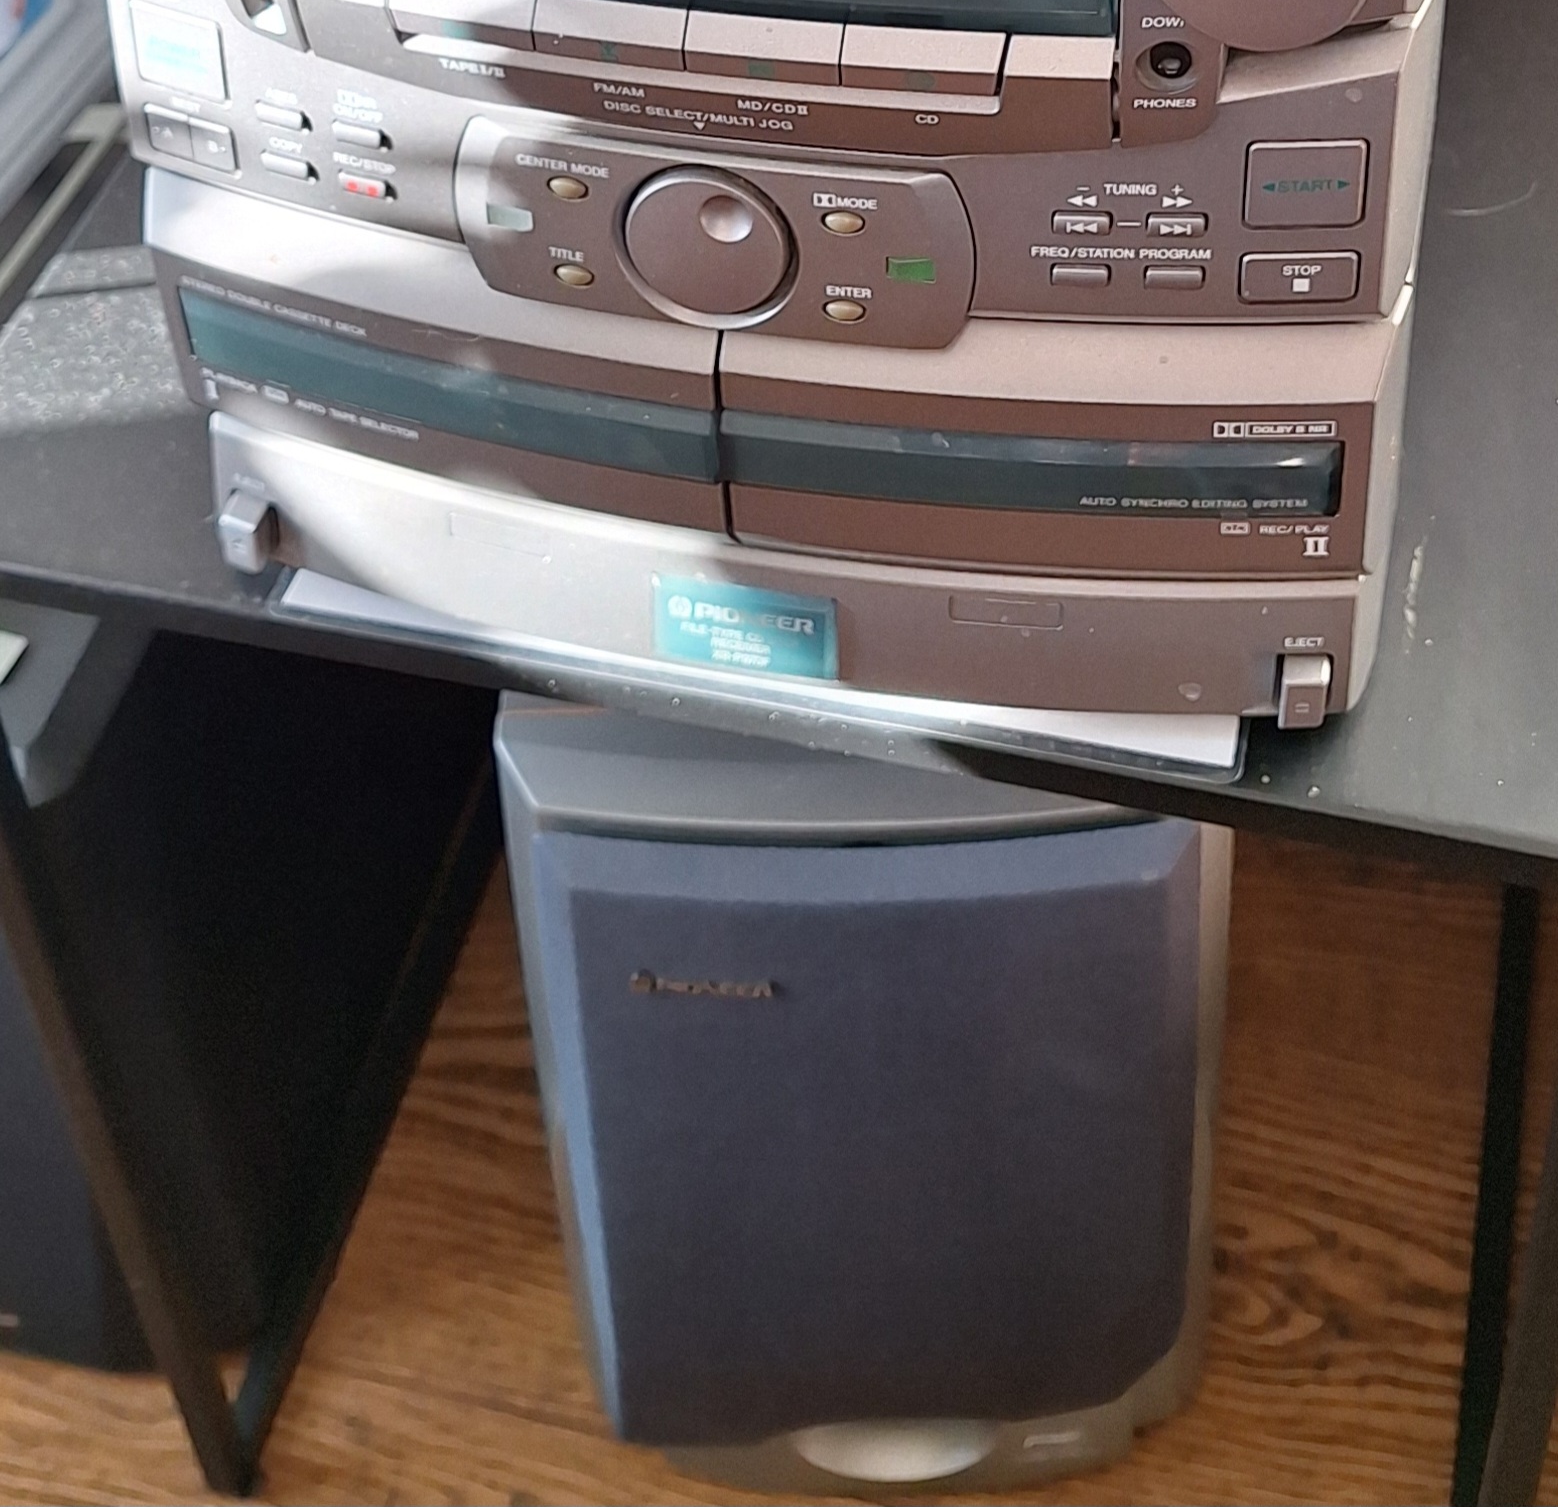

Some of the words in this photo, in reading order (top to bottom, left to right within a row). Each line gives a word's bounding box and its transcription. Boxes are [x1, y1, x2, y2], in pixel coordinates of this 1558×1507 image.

[439, 58, 479, 76] TAPE
[593, 82, 646, 98] FM/AM
[1133, 98, 1198, 109] PHONES
[603, 99, 642, 114] DISC
[645, 104, 756, 127] SELECT/MULTI
[758, 118, 794, 132] JOG
[914, 113, 940, 126] CD
[515, 153, 568, 172] CENTER
[570, 162, 610, 179] MODE
[1104, 183, 1157, 196] TUNING
[1277, 178, 1334, 193] START
[837, 197, 878, 210] MODE
[548, 246, 584, 262] TITLE
[1030, 246, 1135, 260] FREQ/STATION
[1139, 247, 1212, 260] PROGRAM
[1282, 264, 1322, 277] STOP
[825, 285, 873, 299] ENTER
[273, 303, 332, 328] CASSETTE
[335, 320, 368, 337] DECK
[358, 415, 420, 442] SELECTOR
[1251, 425, 1295, 434] DOLBY
[1080, 496, 1117, 508] AUTO
[1120, 497, 1189, 509] SYNCHRO
[1191, 498, 1248, 509] EDITING
[1252, 498, 1310, 510] SYSTEM
[1284, 636, 1325, 648] EJECT
